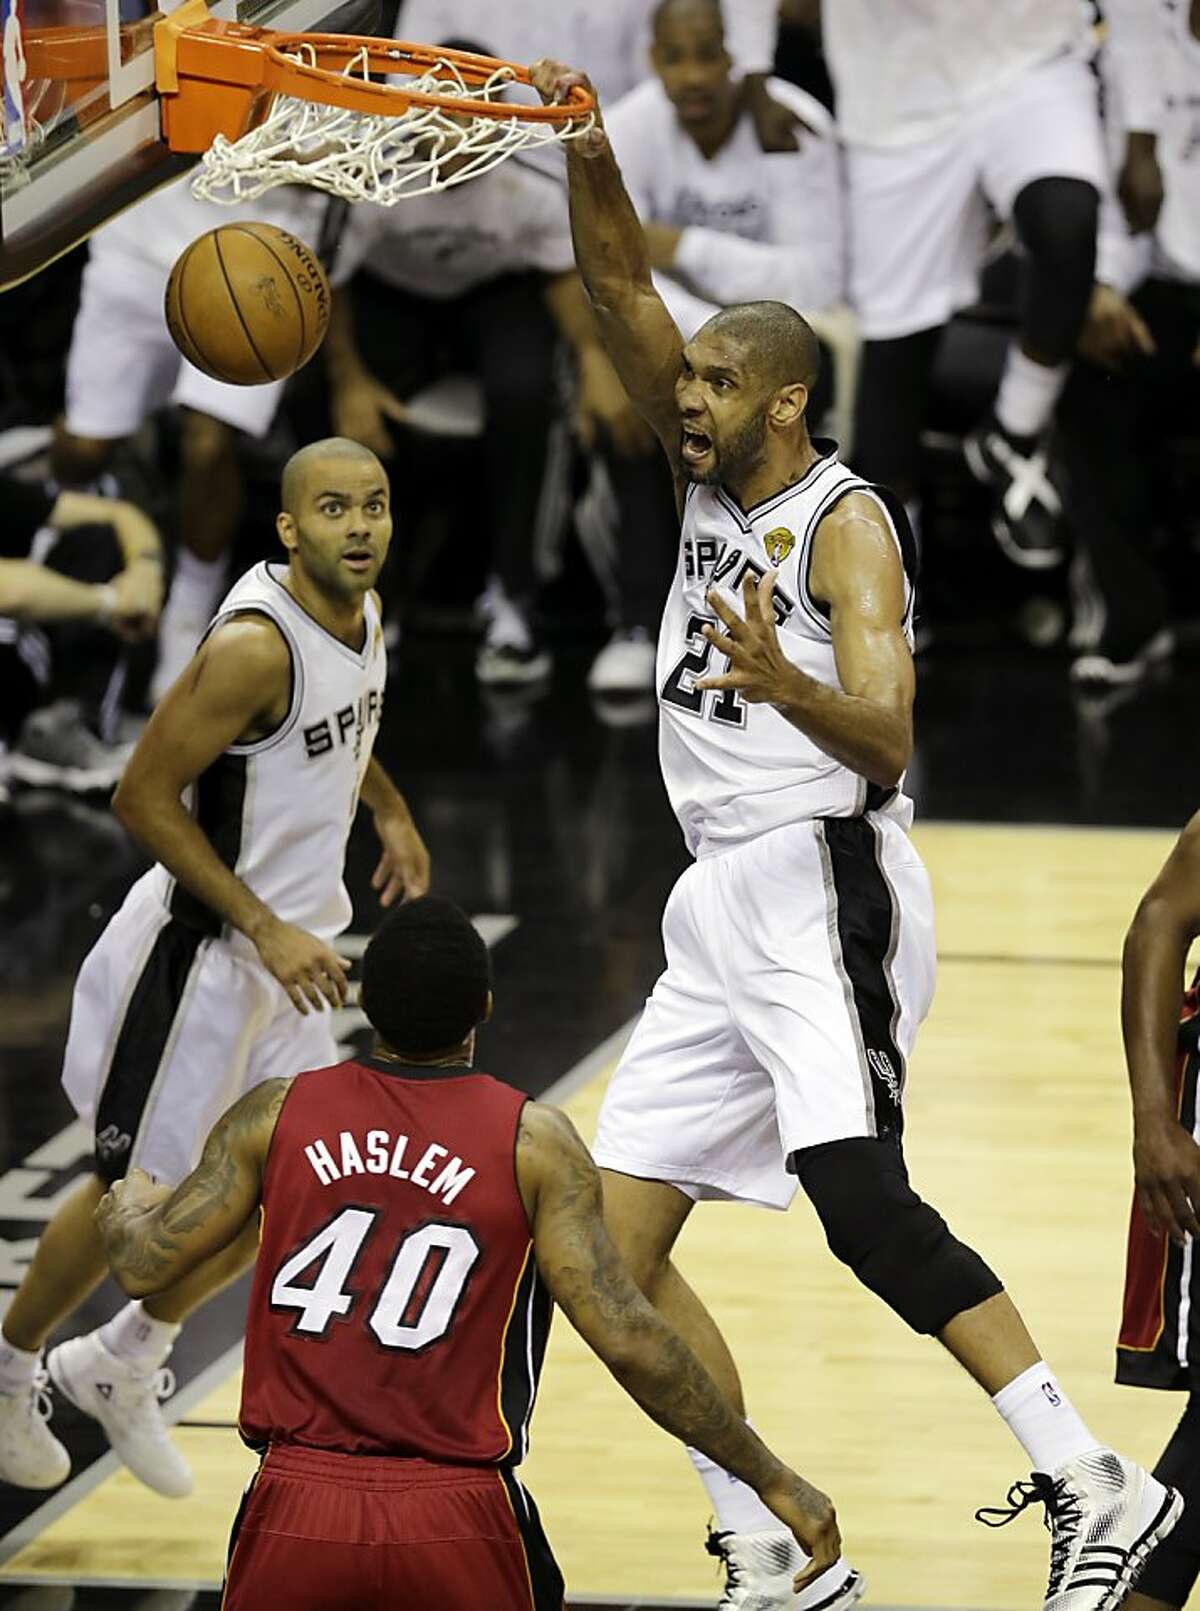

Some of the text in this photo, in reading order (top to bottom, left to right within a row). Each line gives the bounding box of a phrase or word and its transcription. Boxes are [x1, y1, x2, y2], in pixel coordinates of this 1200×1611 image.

[661, 611, 748, 730] 21
[304, 1130, 476, 1206] HASLEM
[270, 1207, 481, 1350] 40
